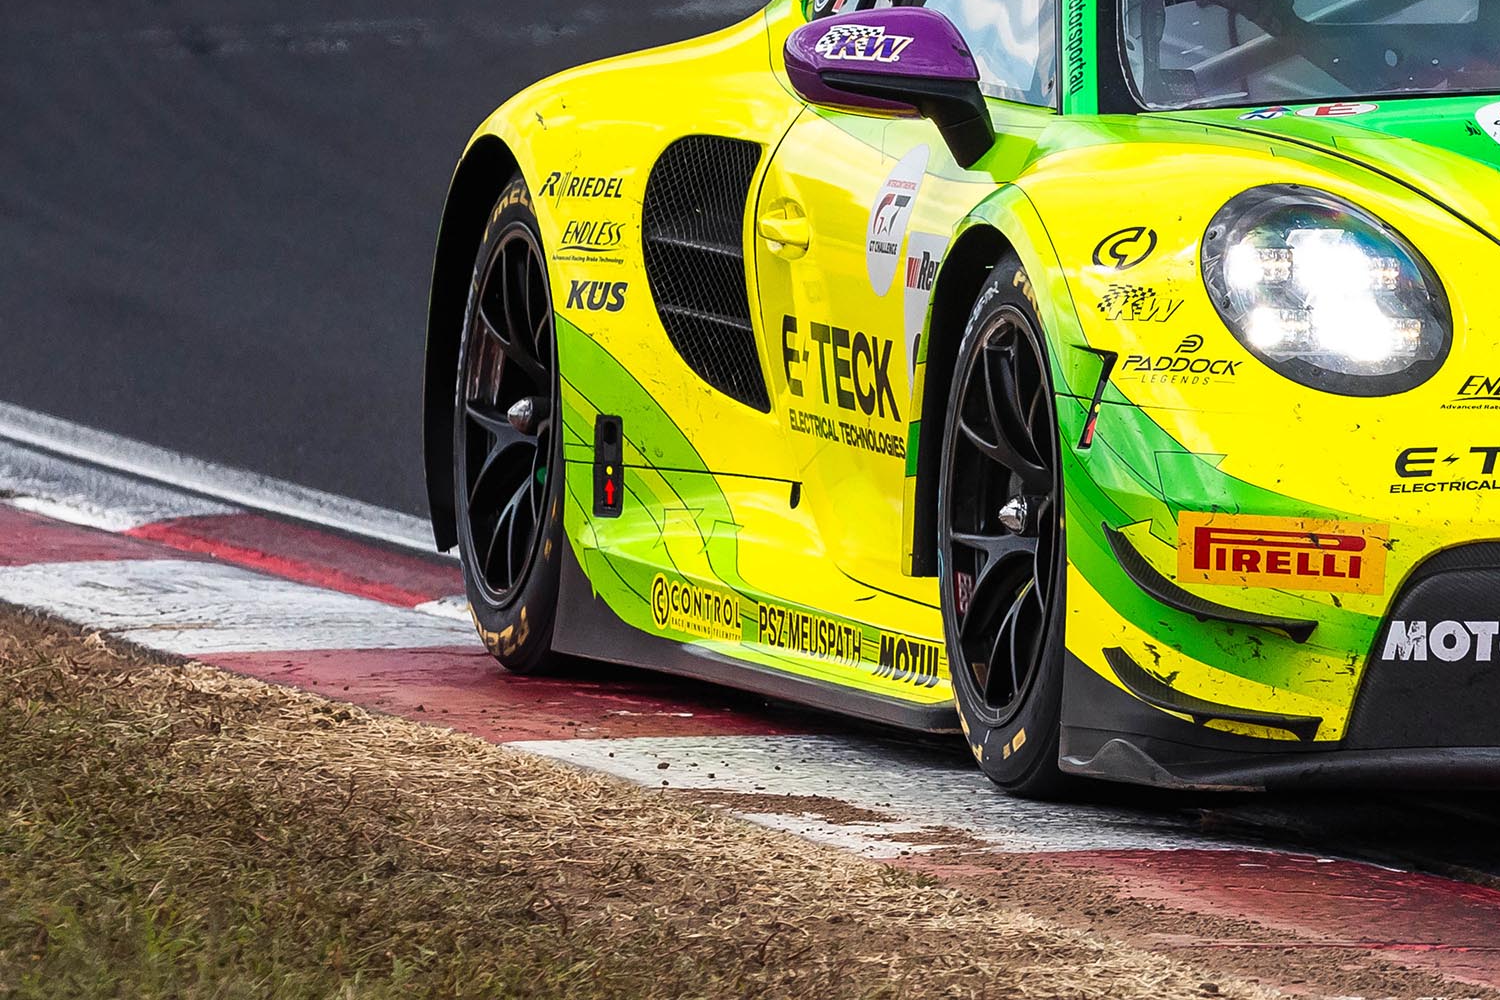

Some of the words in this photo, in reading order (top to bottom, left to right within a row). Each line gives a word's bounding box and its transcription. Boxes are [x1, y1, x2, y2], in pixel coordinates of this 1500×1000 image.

[566, 176, 623, 198] RIEDEL
[561, 220, 626, 246] ENDLESS
[1121, 355, 1243, 375] PADDOCK
[1141, 374, 1210, 385] LEGENDS
[789, 408, 840, 442] ELECTRICAL
[839, 421, 906, 459] TECHNOLOGIES
[1193, 525, 1367, 579] PIRELLI
[671, 584, 741, 628] CONTROL
[872, 633, 940, 688] MOTUL
